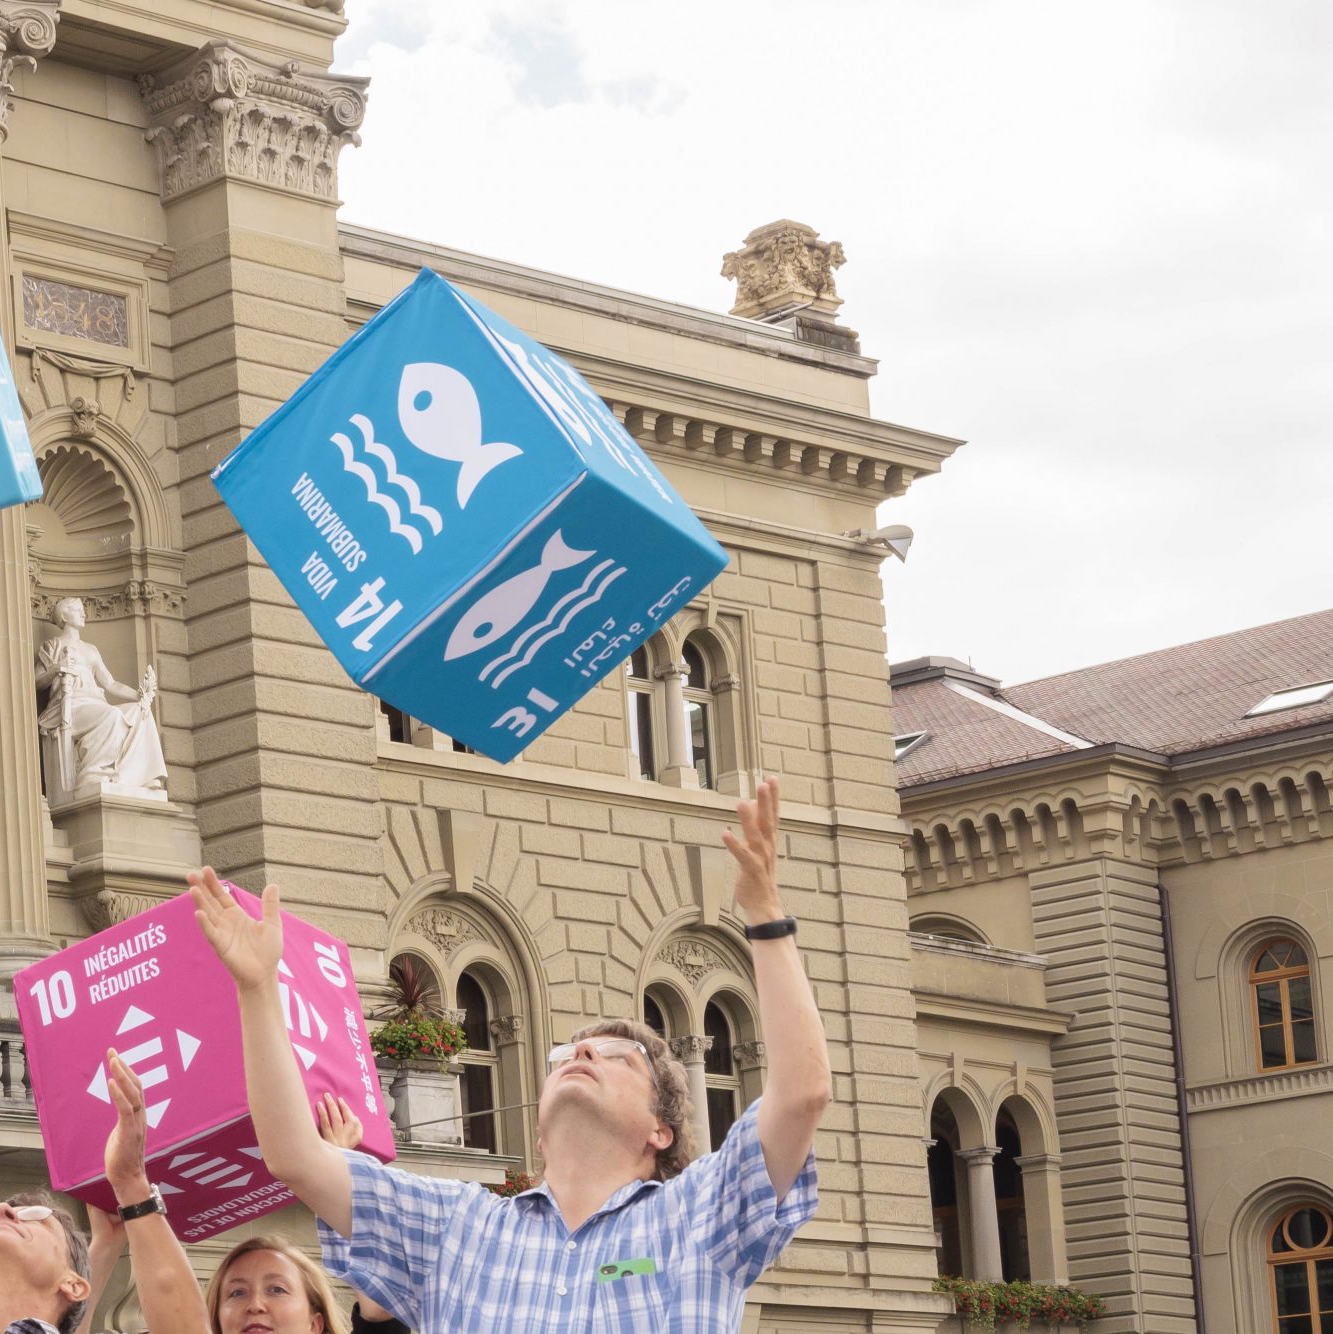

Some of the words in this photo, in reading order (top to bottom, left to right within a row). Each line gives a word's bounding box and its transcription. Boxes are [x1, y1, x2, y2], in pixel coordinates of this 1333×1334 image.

[291, 471, 367, 572] SUBMARINA
[300, 551, 338, 600] VIDA
[334, 576, 403, 653] 14
[581, 623, 645, 678] الحياة
[647, 575, 692, 619] تحت
[563, 617, 616, 668] الماء
[83, 923, 166, 977] INÉGALITÉS
[312, 941, 347, 988] 10
[30, 970, 77, 1026] 10
[89, 957, 161, 1004] RÉDUITES
[187, 1181, 286, 1223] SIGUALDADES
[213, 1215, 236, 1226] DE
[183, 1224, 213, 1237] LAS
